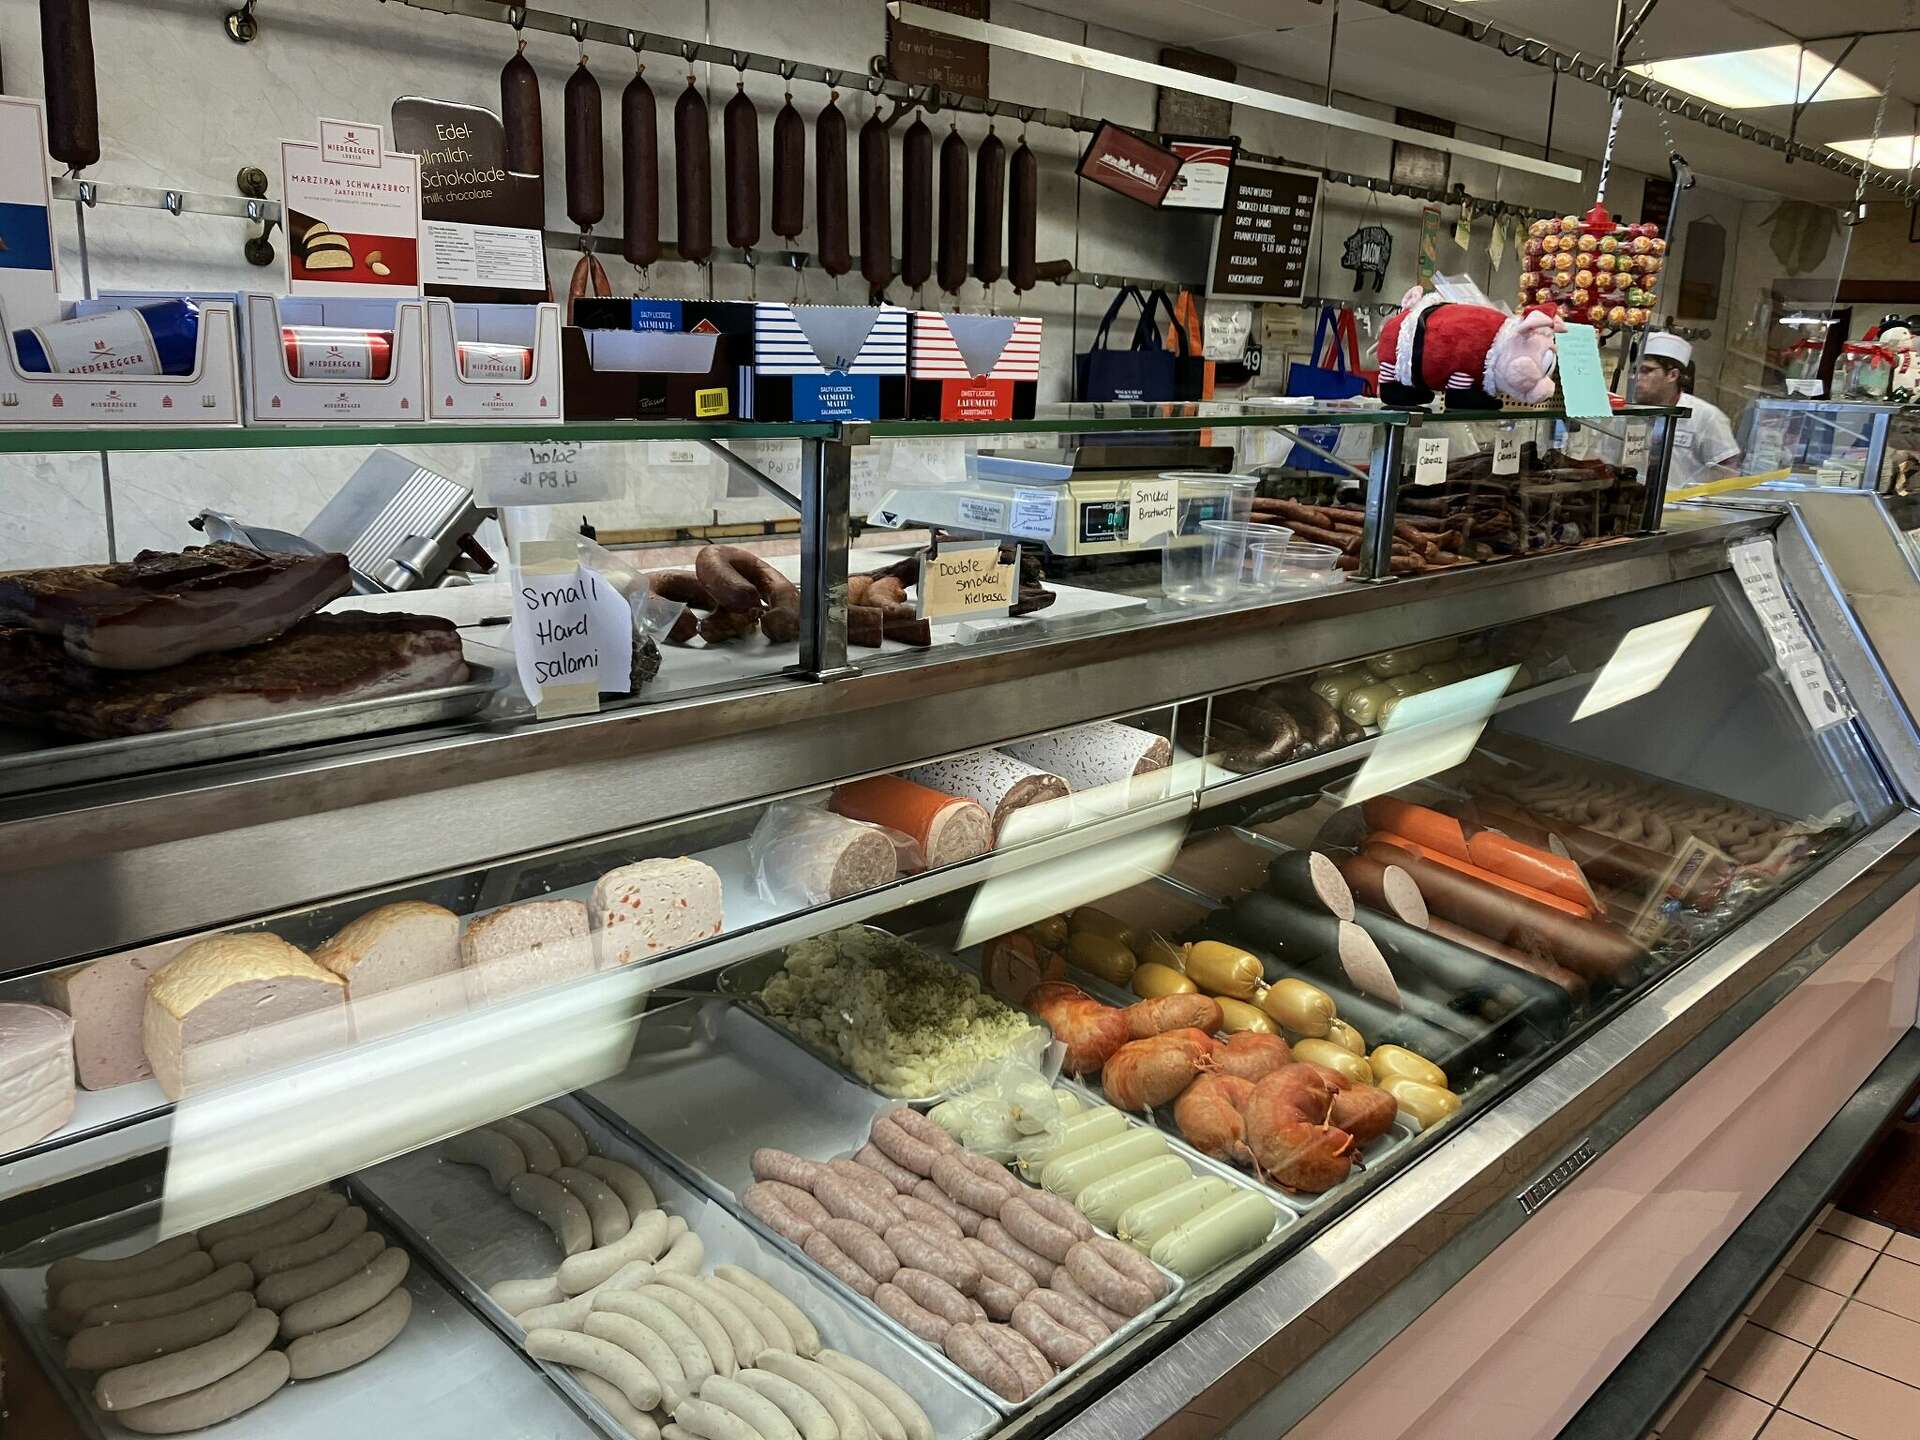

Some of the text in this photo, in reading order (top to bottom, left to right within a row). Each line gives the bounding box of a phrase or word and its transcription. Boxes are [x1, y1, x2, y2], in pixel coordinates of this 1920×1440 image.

[436, 123, 473, 141] Edel-
[327, 144, 375, 155] NIEDEREGGER
[413, 147, 473, 166] ollmilch-
[291, 175, 410, 193] MARZIPAN SCHWARZBROT
[422, 166, 505, 188] Schokolade
[423, 189, 493, 204] milk chocolate
[1240, 185, 1272, 198] BRATWURST
[1237, 201, 1258, 212] SMOKED
[69, 354, 145, 375] NIEDEREGGER
[309, 360, 361, 368] NIEDEREGGER
[1243, 351, 1261, 370] 49
[939, 559, 983, 577] Double
[522, 577, 598, 610] Small
[536, 613, 588, 645] Hard
